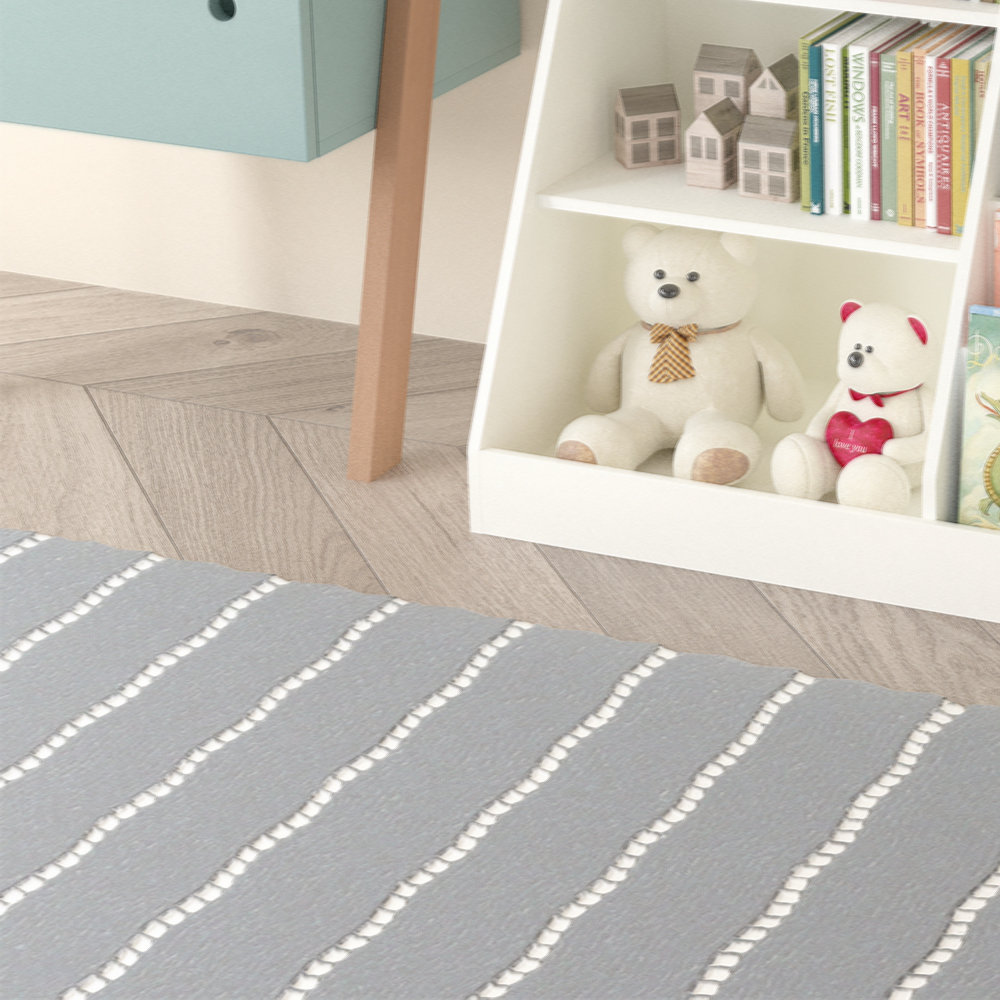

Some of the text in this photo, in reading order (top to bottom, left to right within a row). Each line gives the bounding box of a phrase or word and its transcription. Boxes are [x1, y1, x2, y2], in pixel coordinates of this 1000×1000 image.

[825, 49, 837, 123] LOST FISH
[852, 52, 866, 123] WINDOWS
[898, 93, 910, 121] ART
[915, 92, 925, 128] BOOK
[915, 141, 926, 204] SYMBOLS
[941, 103, 950, 190] ANTIQUAIRES
